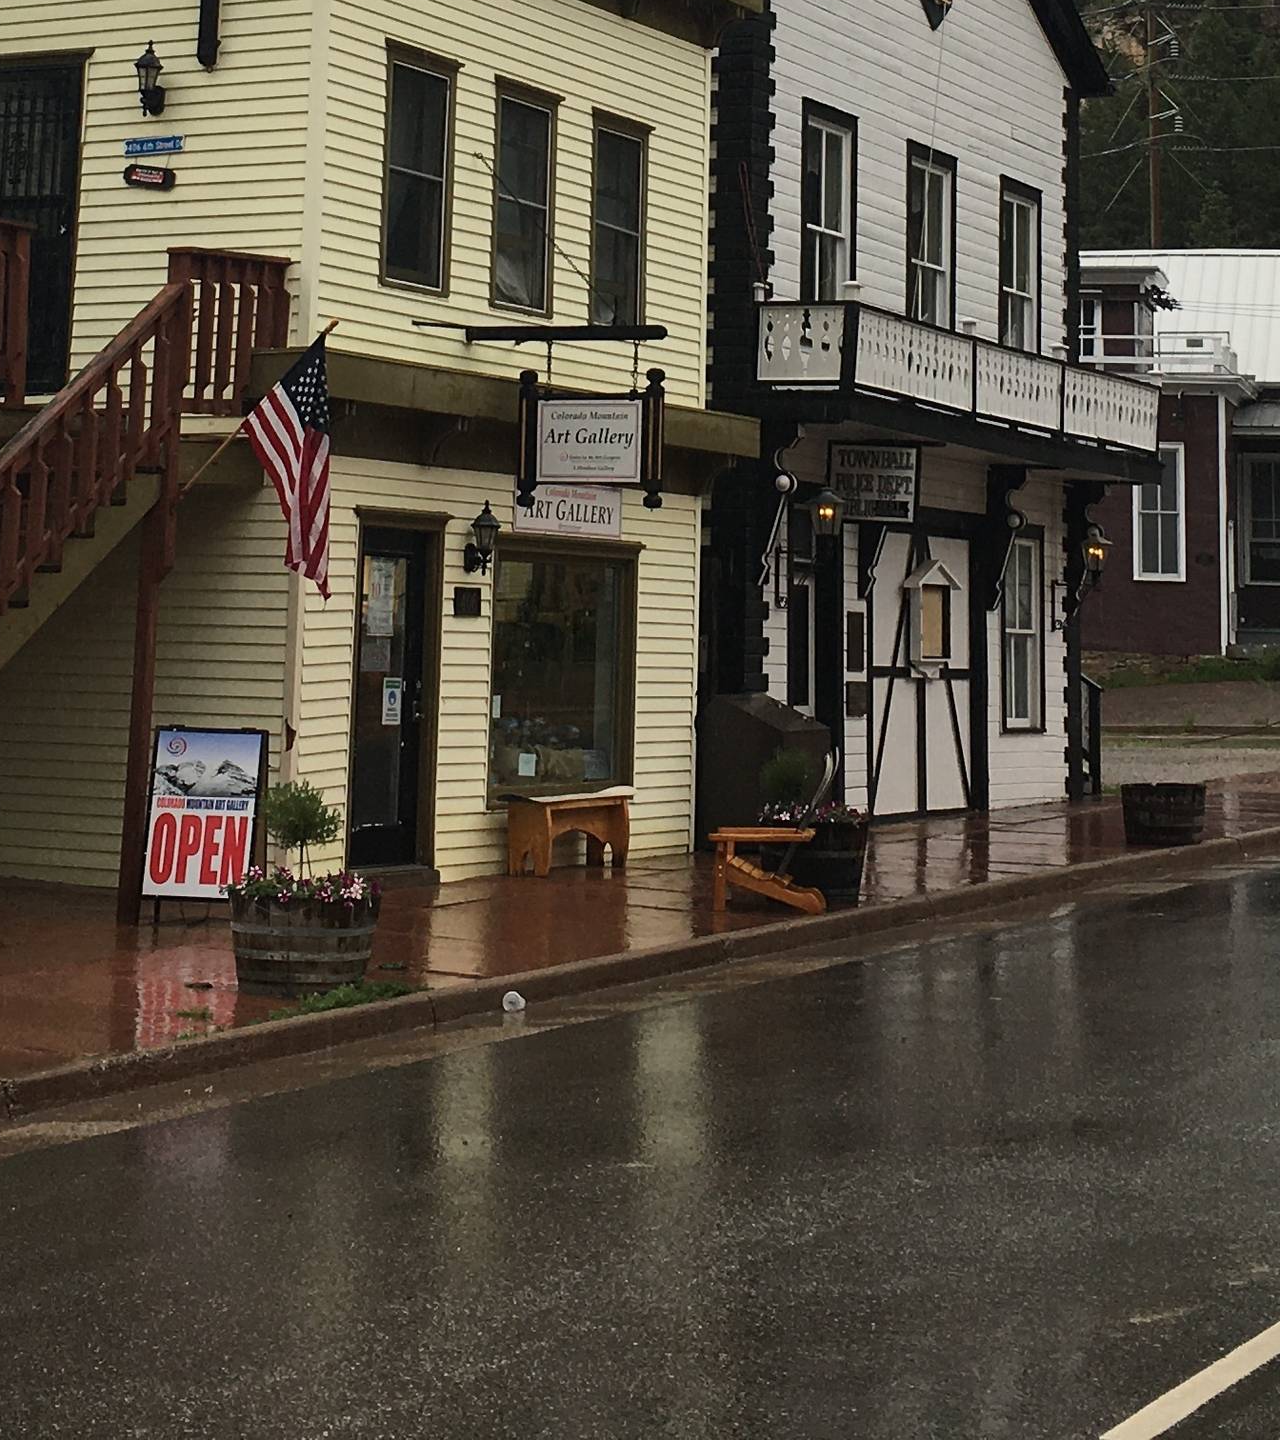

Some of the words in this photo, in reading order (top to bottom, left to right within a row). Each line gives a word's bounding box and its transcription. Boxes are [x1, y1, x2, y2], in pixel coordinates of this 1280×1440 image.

[551, 411, 587, 420] Colorado
[590, 411, 629, 420] Mountain
[544, 428, 570, 444] Art
[575, 427, 634, 449] Gallery
[556, 499, 614, 525] GALLERY
[157, 797, 186, 809] COLORADO
[186, 798, 215, 810] MOUNTAIN
[215, 799, 226, 811] ART
[226, 800, 249, 811] GALLERY
[149, 812, 249, 886] OPEN
